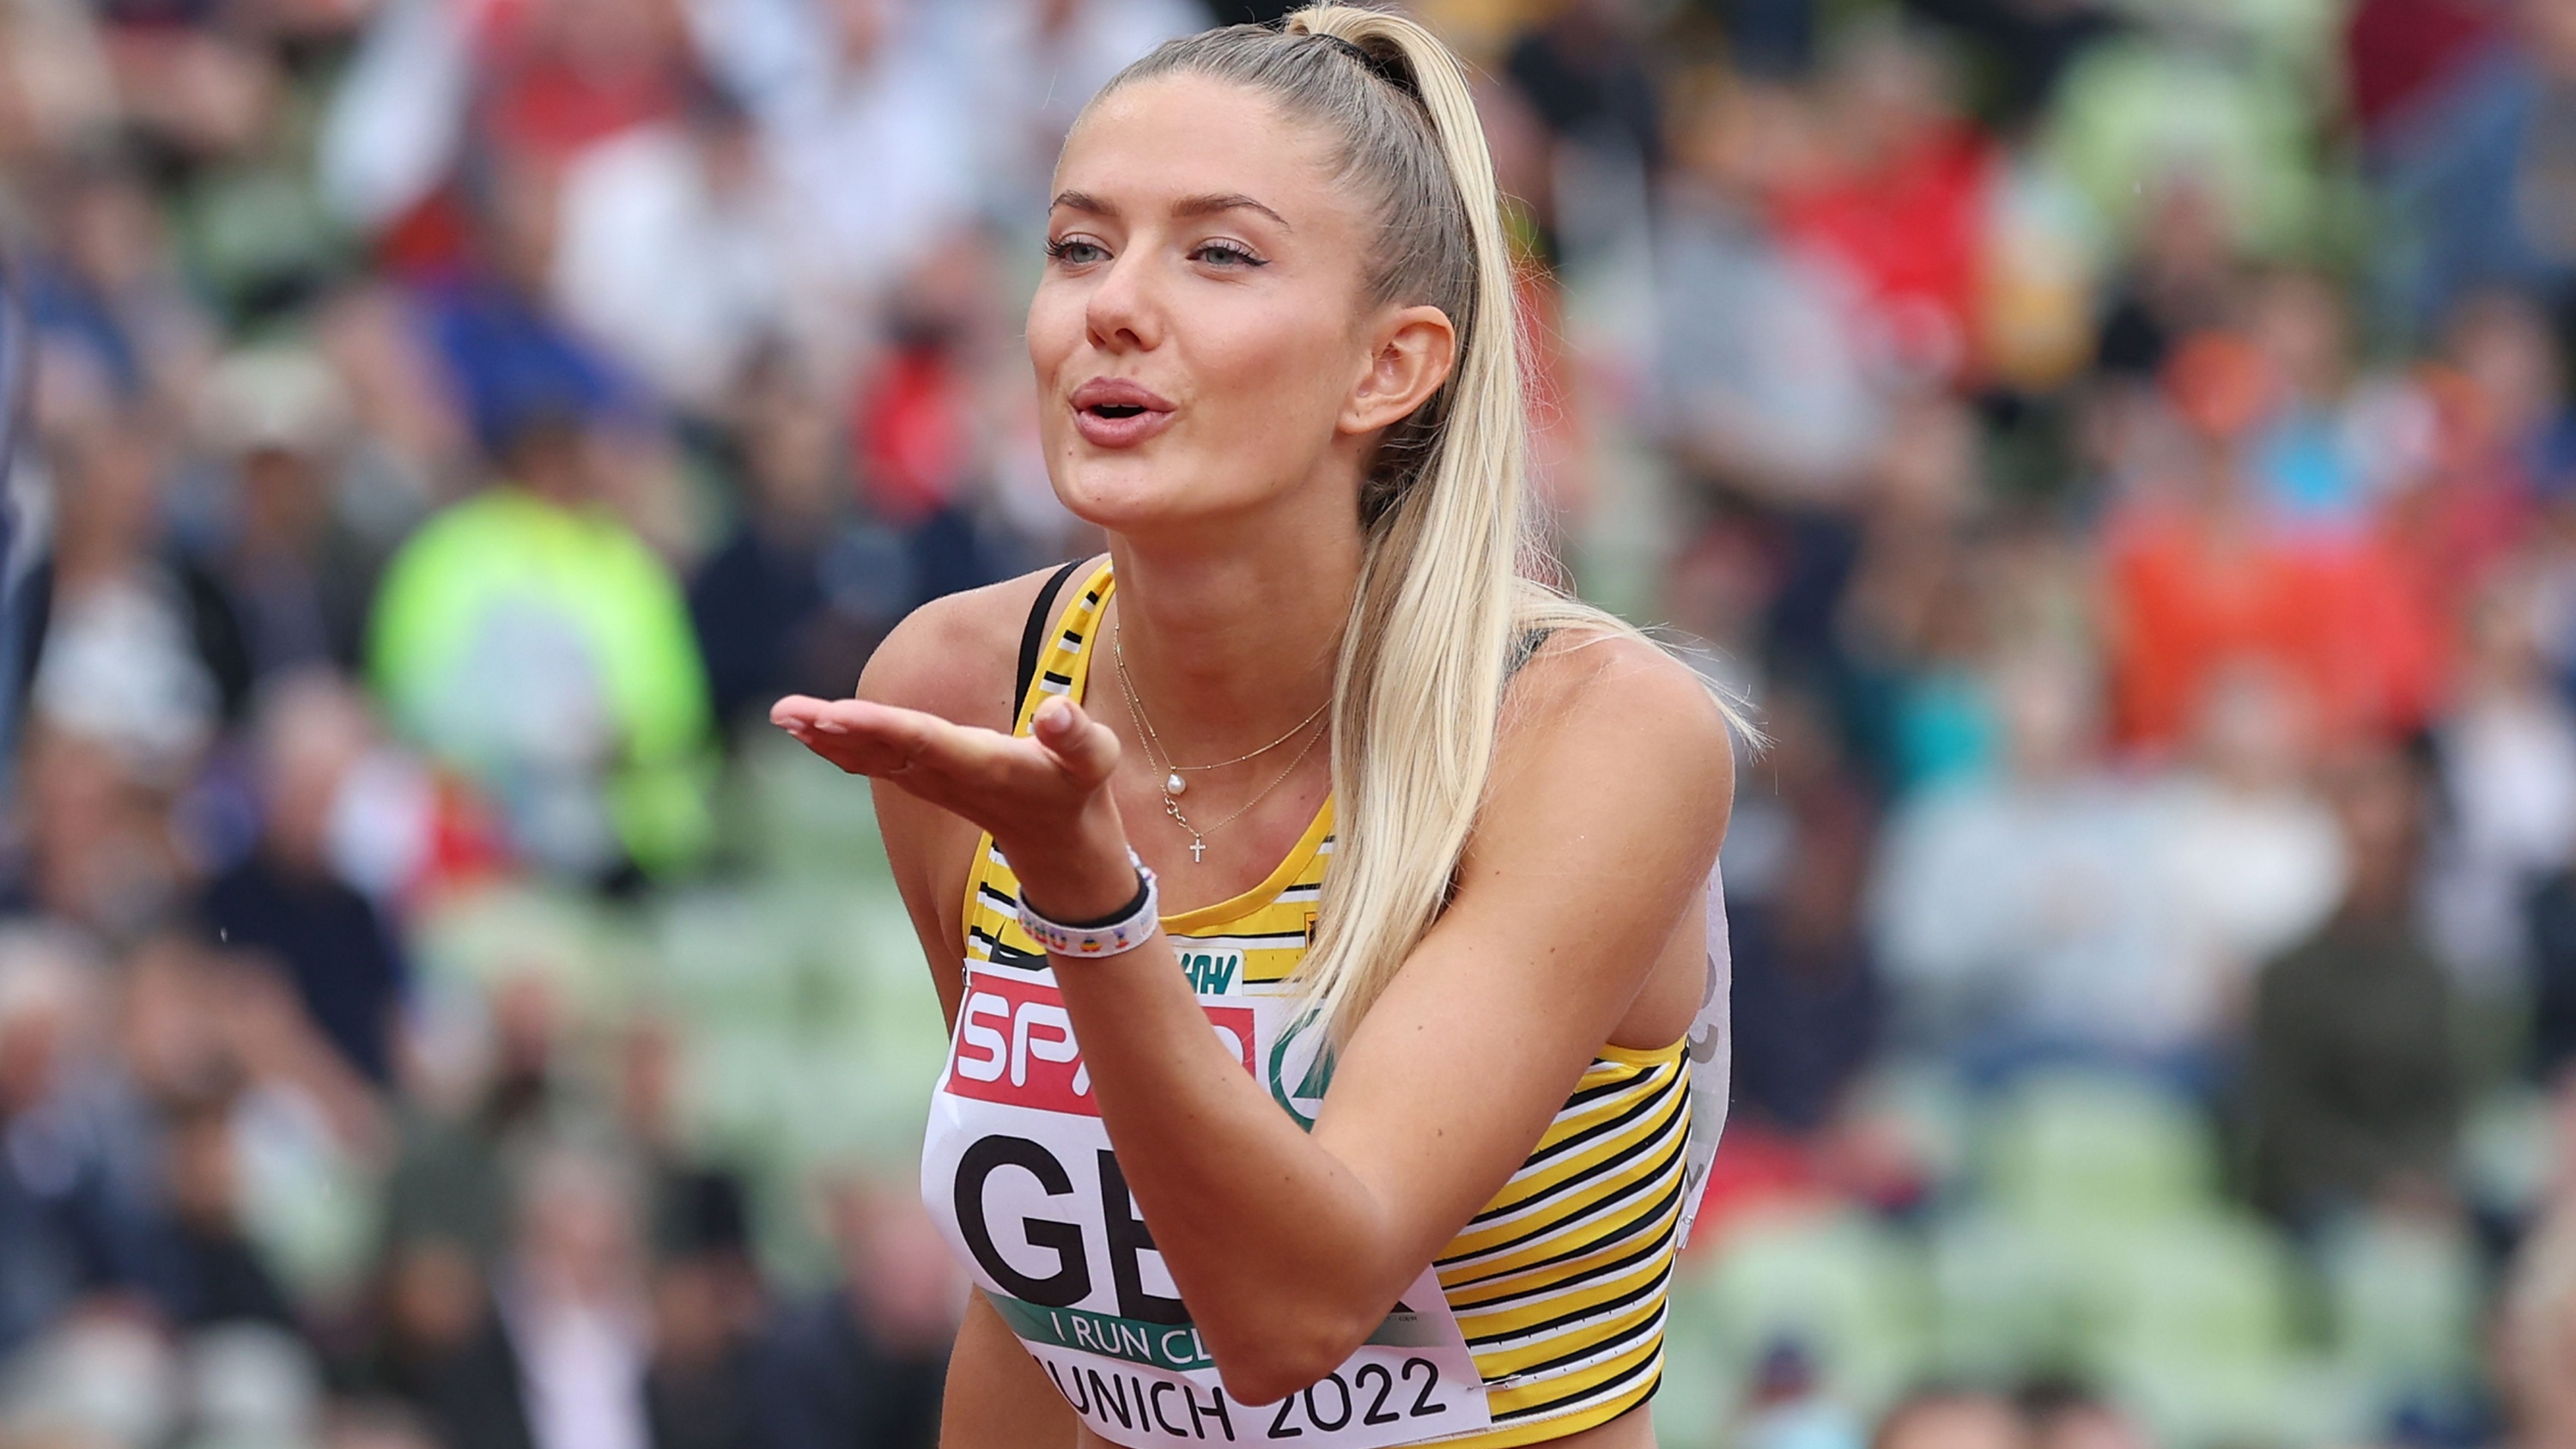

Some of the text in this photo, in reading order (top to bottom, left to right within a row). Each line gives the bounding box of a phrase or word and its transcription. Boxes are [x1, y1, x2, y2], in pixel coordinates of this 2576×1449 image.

[1050, 1311, 1066, 1342] I
[1071, 1315, 1152, 1361] RUN
[1033, 1355, 1447, 1442] UNICH 2022
